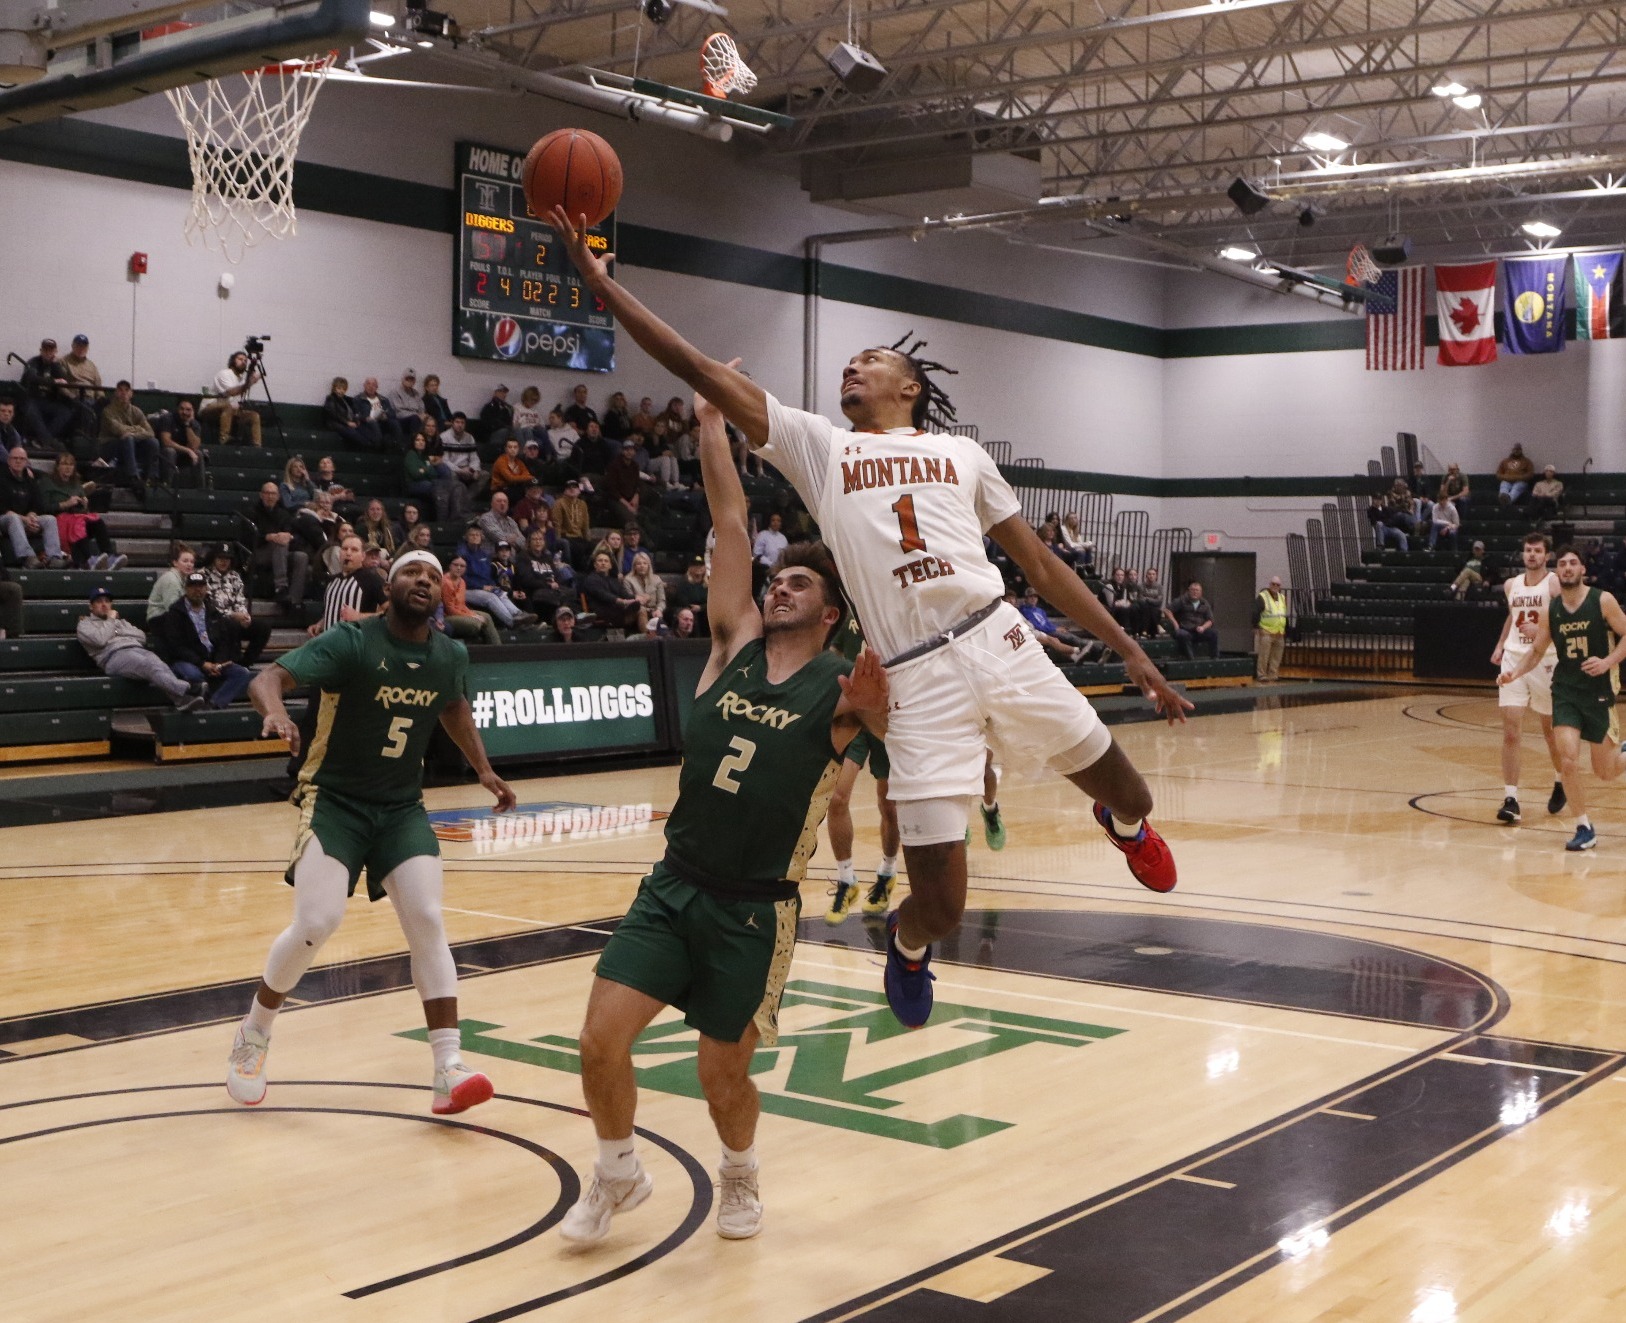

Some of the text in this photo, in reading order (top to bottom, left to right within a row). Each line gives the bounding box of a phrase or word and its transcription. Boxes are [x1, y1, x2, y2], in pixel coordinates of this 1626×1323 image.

[469, 147, 525, 179] HOME O
[465, 212, 515, 233] DIGGERS
[536, 245, 546, 265] 2
[470, 261, 491, 273] FOULS
[520, 269, 544, 280] PLAYER
[476, 272, 488, 294] 2
[500, 278, 510, 296] 4
[469, 297, 491, 310] SCORE
[570, 287, 579, 308] 3
[1546, 272, 1555, 338] MONTANA
[525, 332, 580, 357] pepsi
[841, 457, 959, 495] MONTANA
[891, 493, 927, 554] 1
[892, 556, 956, 589] TECH
[1512, 595, 1543, 608] MONTANA
[1559, 620, 1591, 636] ROCKY
[1565, 636, 1589, 659] 24
[374, 685, 439, 709] ROCKY
[472, 683, 654, 728] #ROLLDIGGS
[715, 690, 802, 730] ROCKY
[381, 716, 413, 758] 5
[712, 735, 757, 794] 2
